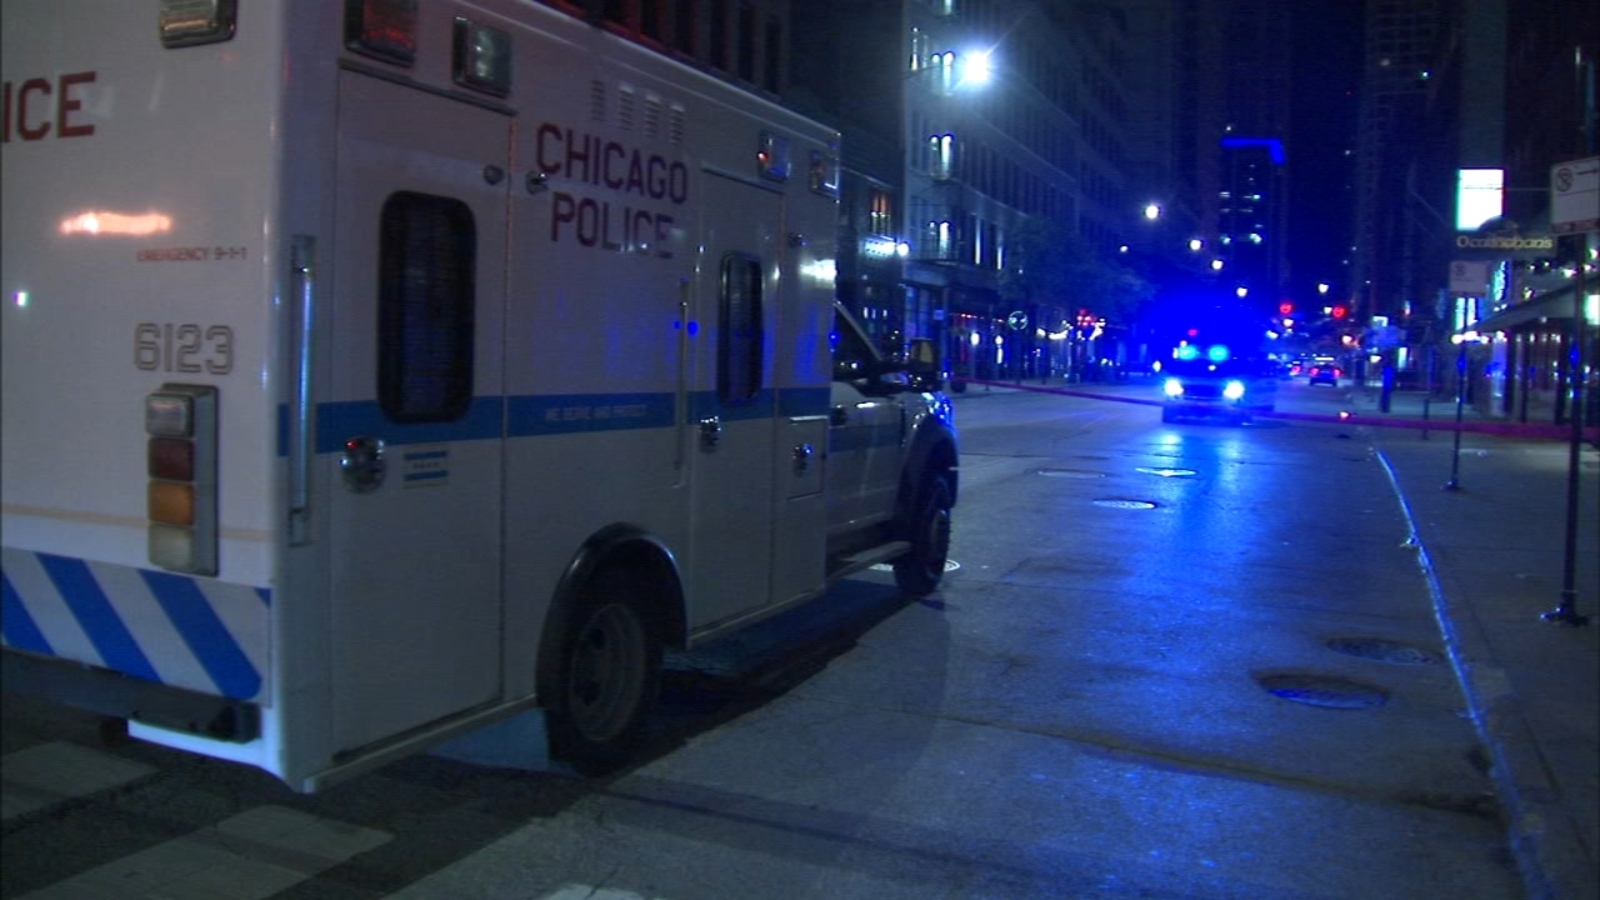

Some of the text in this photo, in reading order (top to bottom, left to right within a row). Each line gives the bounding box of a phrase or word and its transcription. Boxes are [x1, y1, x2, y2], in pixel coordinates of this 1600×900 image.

[537, 122, 688, 205] CHICAGO
[214, 246, 247, 260] 9-1-1
[551, 191, 674, 259] POLICE
[133, 322, 233, 375] 6123
